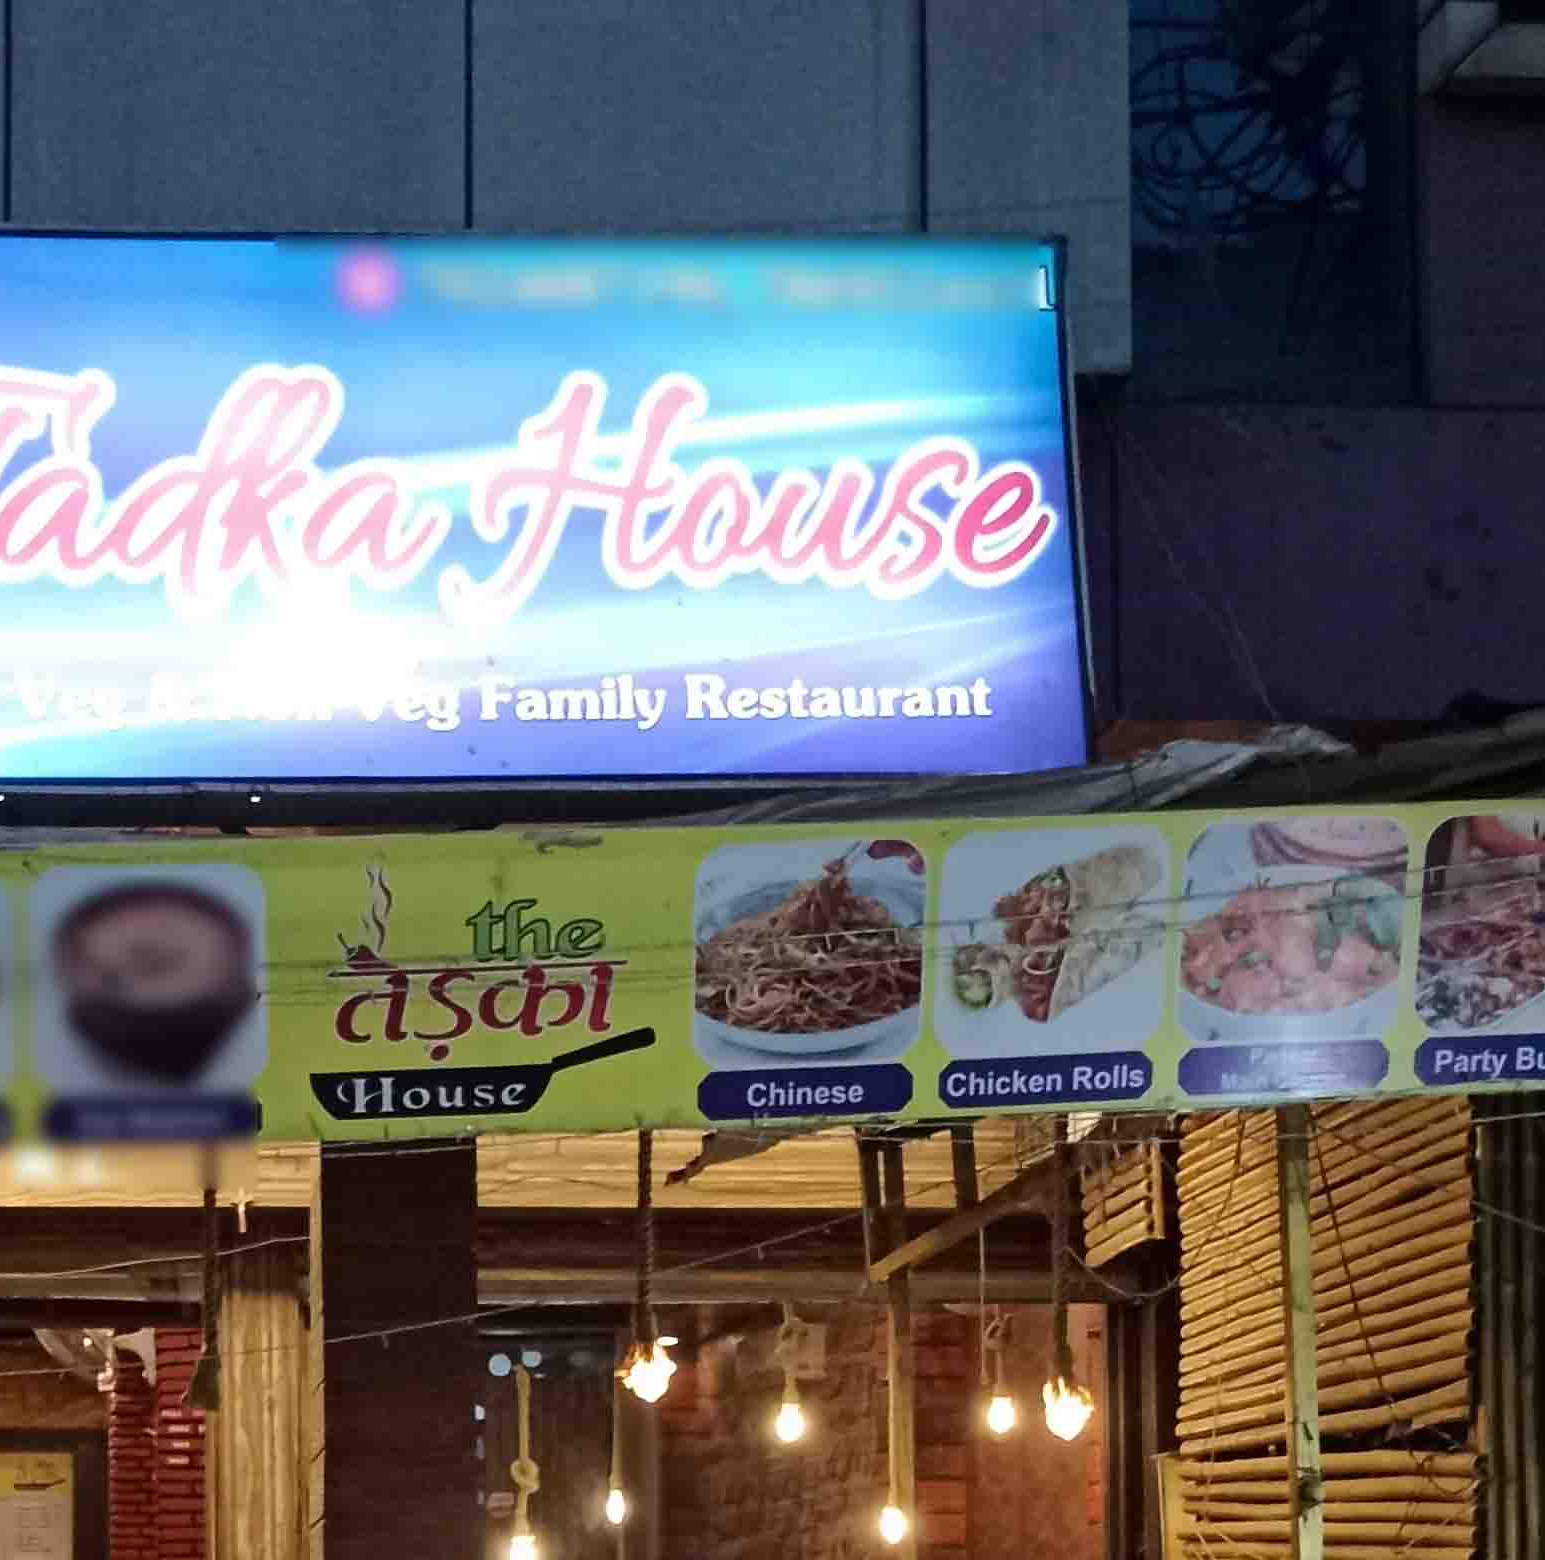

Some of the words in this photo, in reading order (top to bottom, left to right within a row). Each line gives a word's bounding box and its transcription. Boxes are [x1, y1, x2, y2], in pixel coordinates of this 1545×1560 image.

[438, 369, 1056, 627] House
[480, 676, 666, 730] Family
[685, 674, 992, 723] Restaurant
[465, 898, 606, 962] the
[946, 1069, 1063, 1097] Chicken
[1072, 1064, 1145, 1091] Rolls
[1434, 1048, 1508, 1080] Party
[336, 1076, 528, 1114] House
[746, 1081, 865, 1108] Chinese
